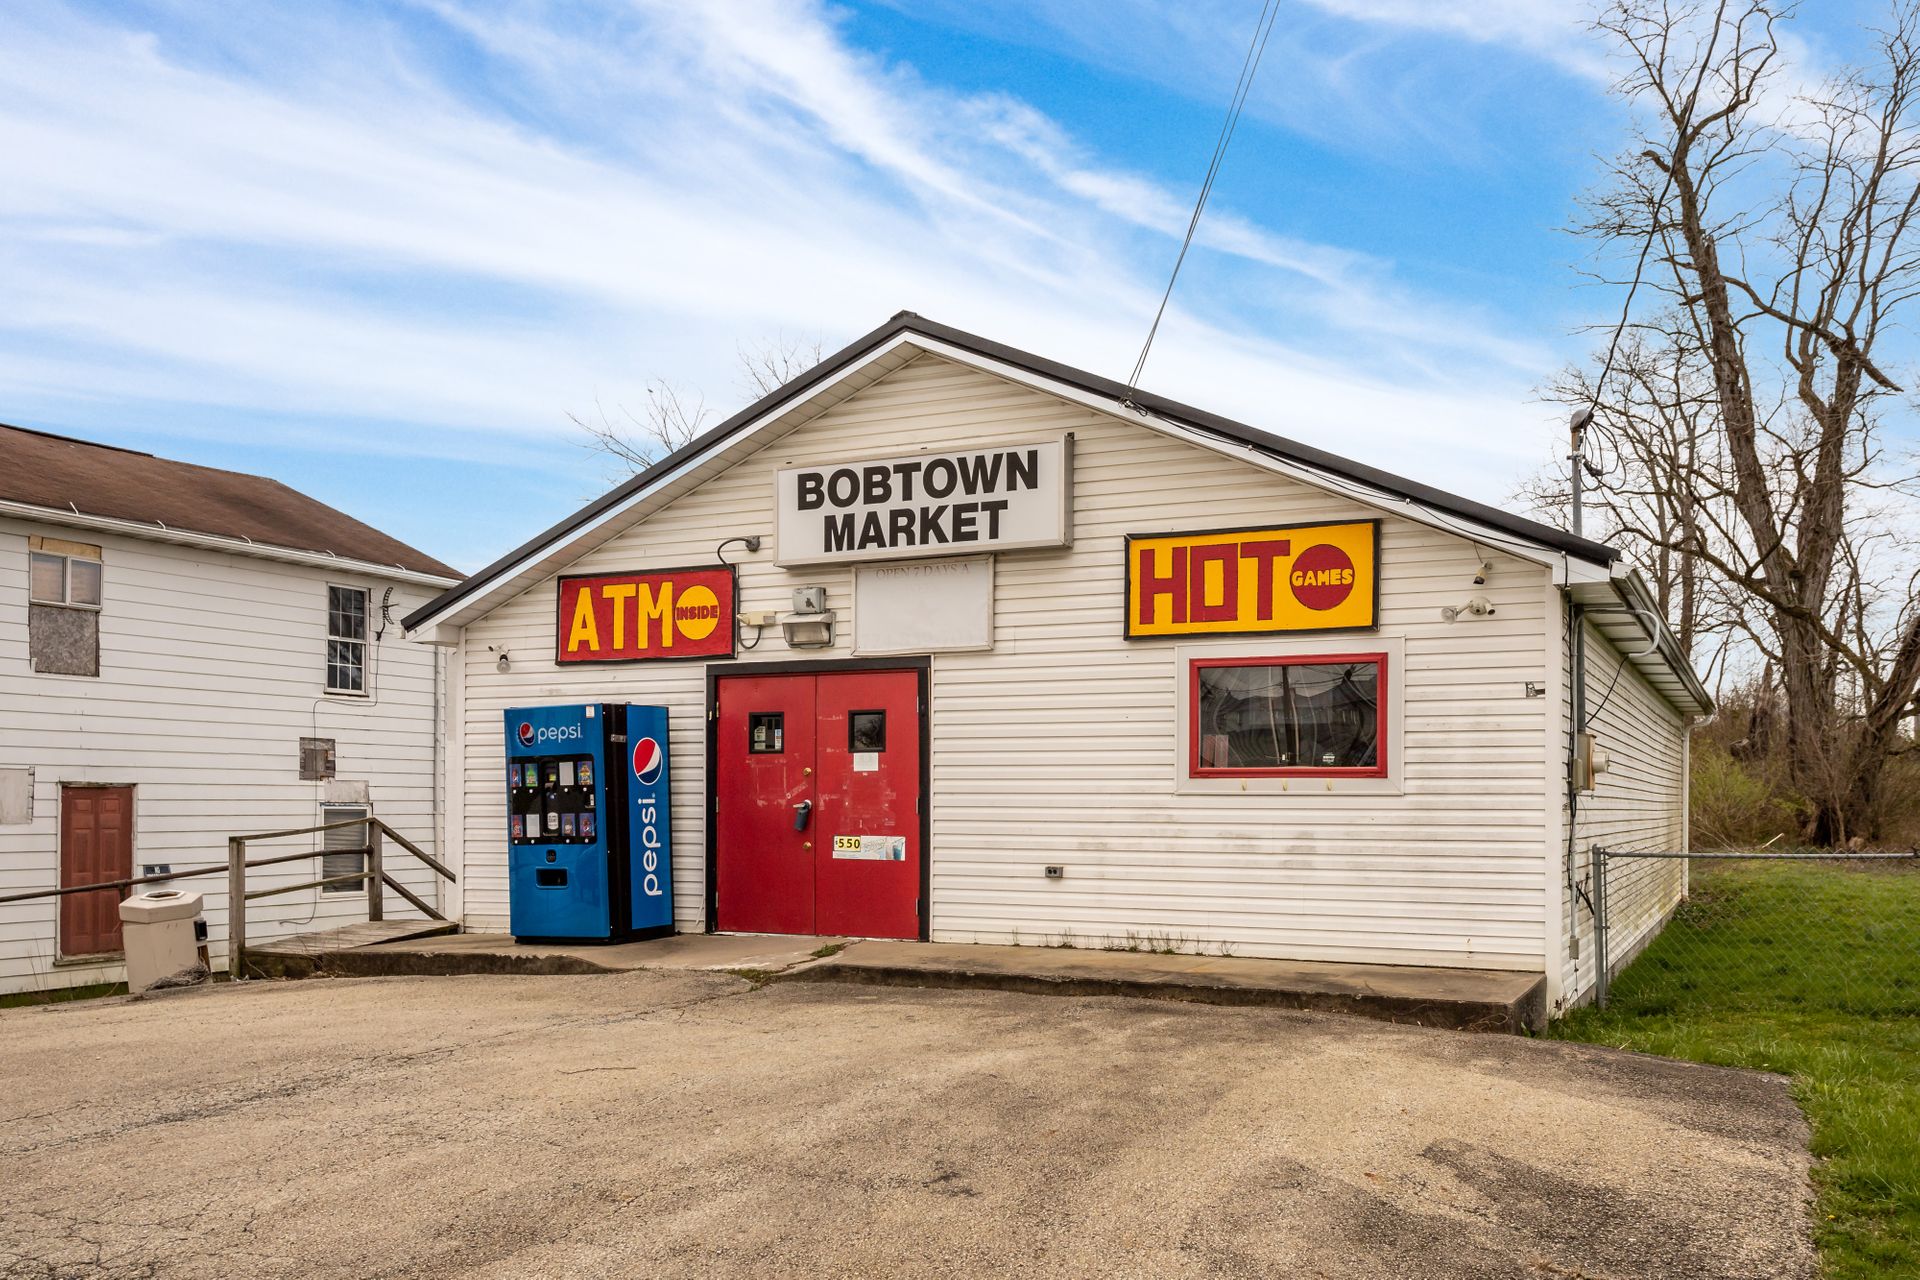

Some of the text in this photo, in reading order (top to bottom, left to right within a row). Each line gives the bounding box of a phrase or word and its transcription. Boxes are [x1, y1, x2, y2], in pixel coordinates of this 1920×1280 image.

[797, 449, 1039, 511] BOBTOWN
[823, 499, 1009, 553] MARKET
[876, 567, 911, 578] OPEN
[913, 566, 920, 577] 7
[923, 564, 958, 577] DAYS
[1139, 539, 1291, 625] HOT
[1291, 569, 1353, 587] GAMES
[567, 581, 674, 652] ATM
[675, 604, 719, 621] INSIDE
[537, 722, 582, 744] pepsi
[638, 797, 663, 896] pepsi
[838, 838, 861, 849] 550
